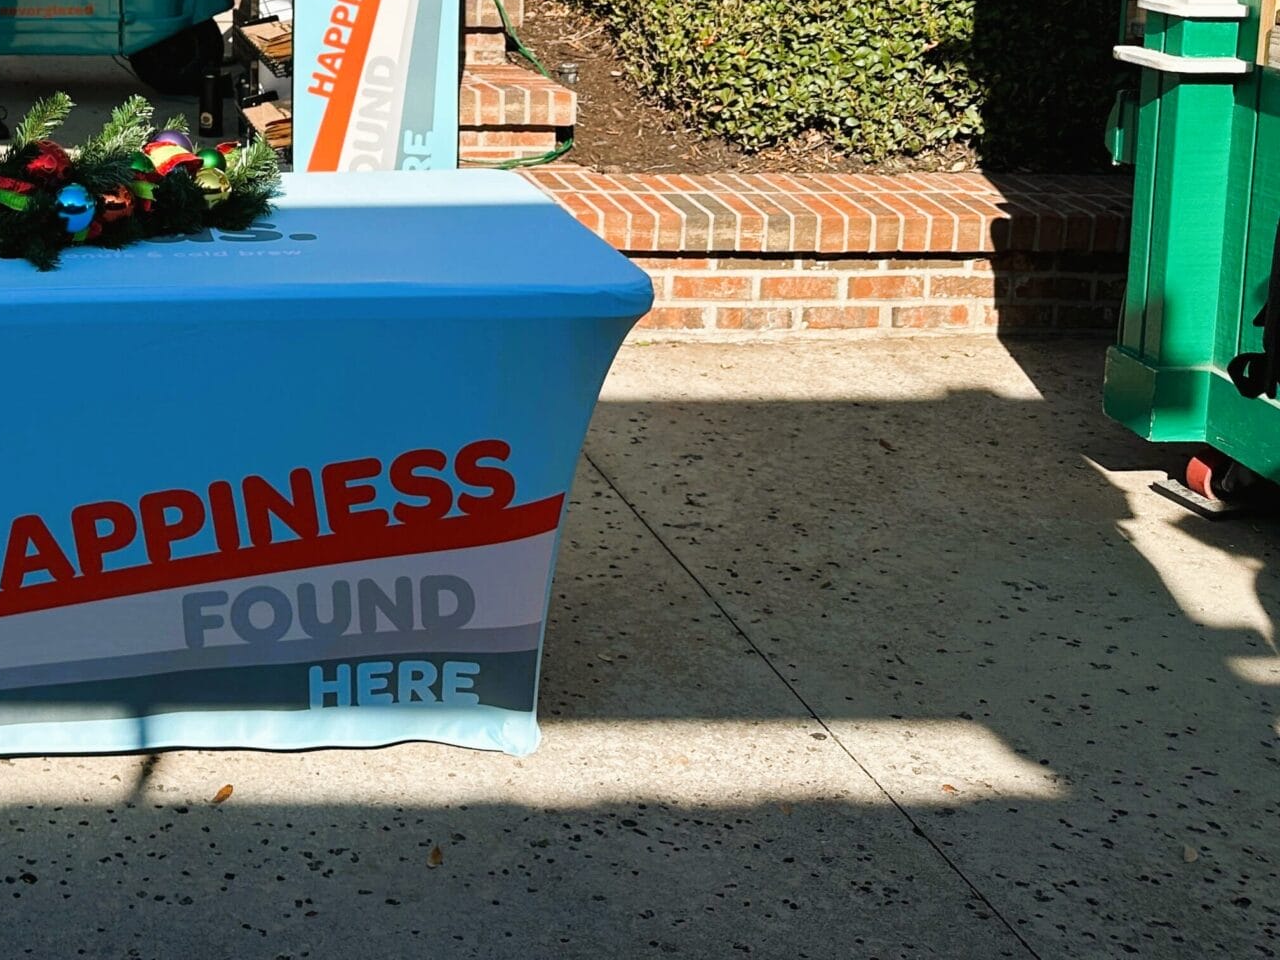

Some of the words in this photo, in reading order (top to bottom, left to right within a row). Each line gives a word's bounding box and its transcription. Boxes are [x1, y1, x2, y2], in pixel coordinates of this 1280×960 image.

[349, 55, 399, 172] OUND
[402, 129, 434, 171] RE
[61, 249, 135, 259] onuts
[239, 248, 302, 257] brew
[182, 574, 476, 649] FOUND
[309, 661, 480, 710] HERE
